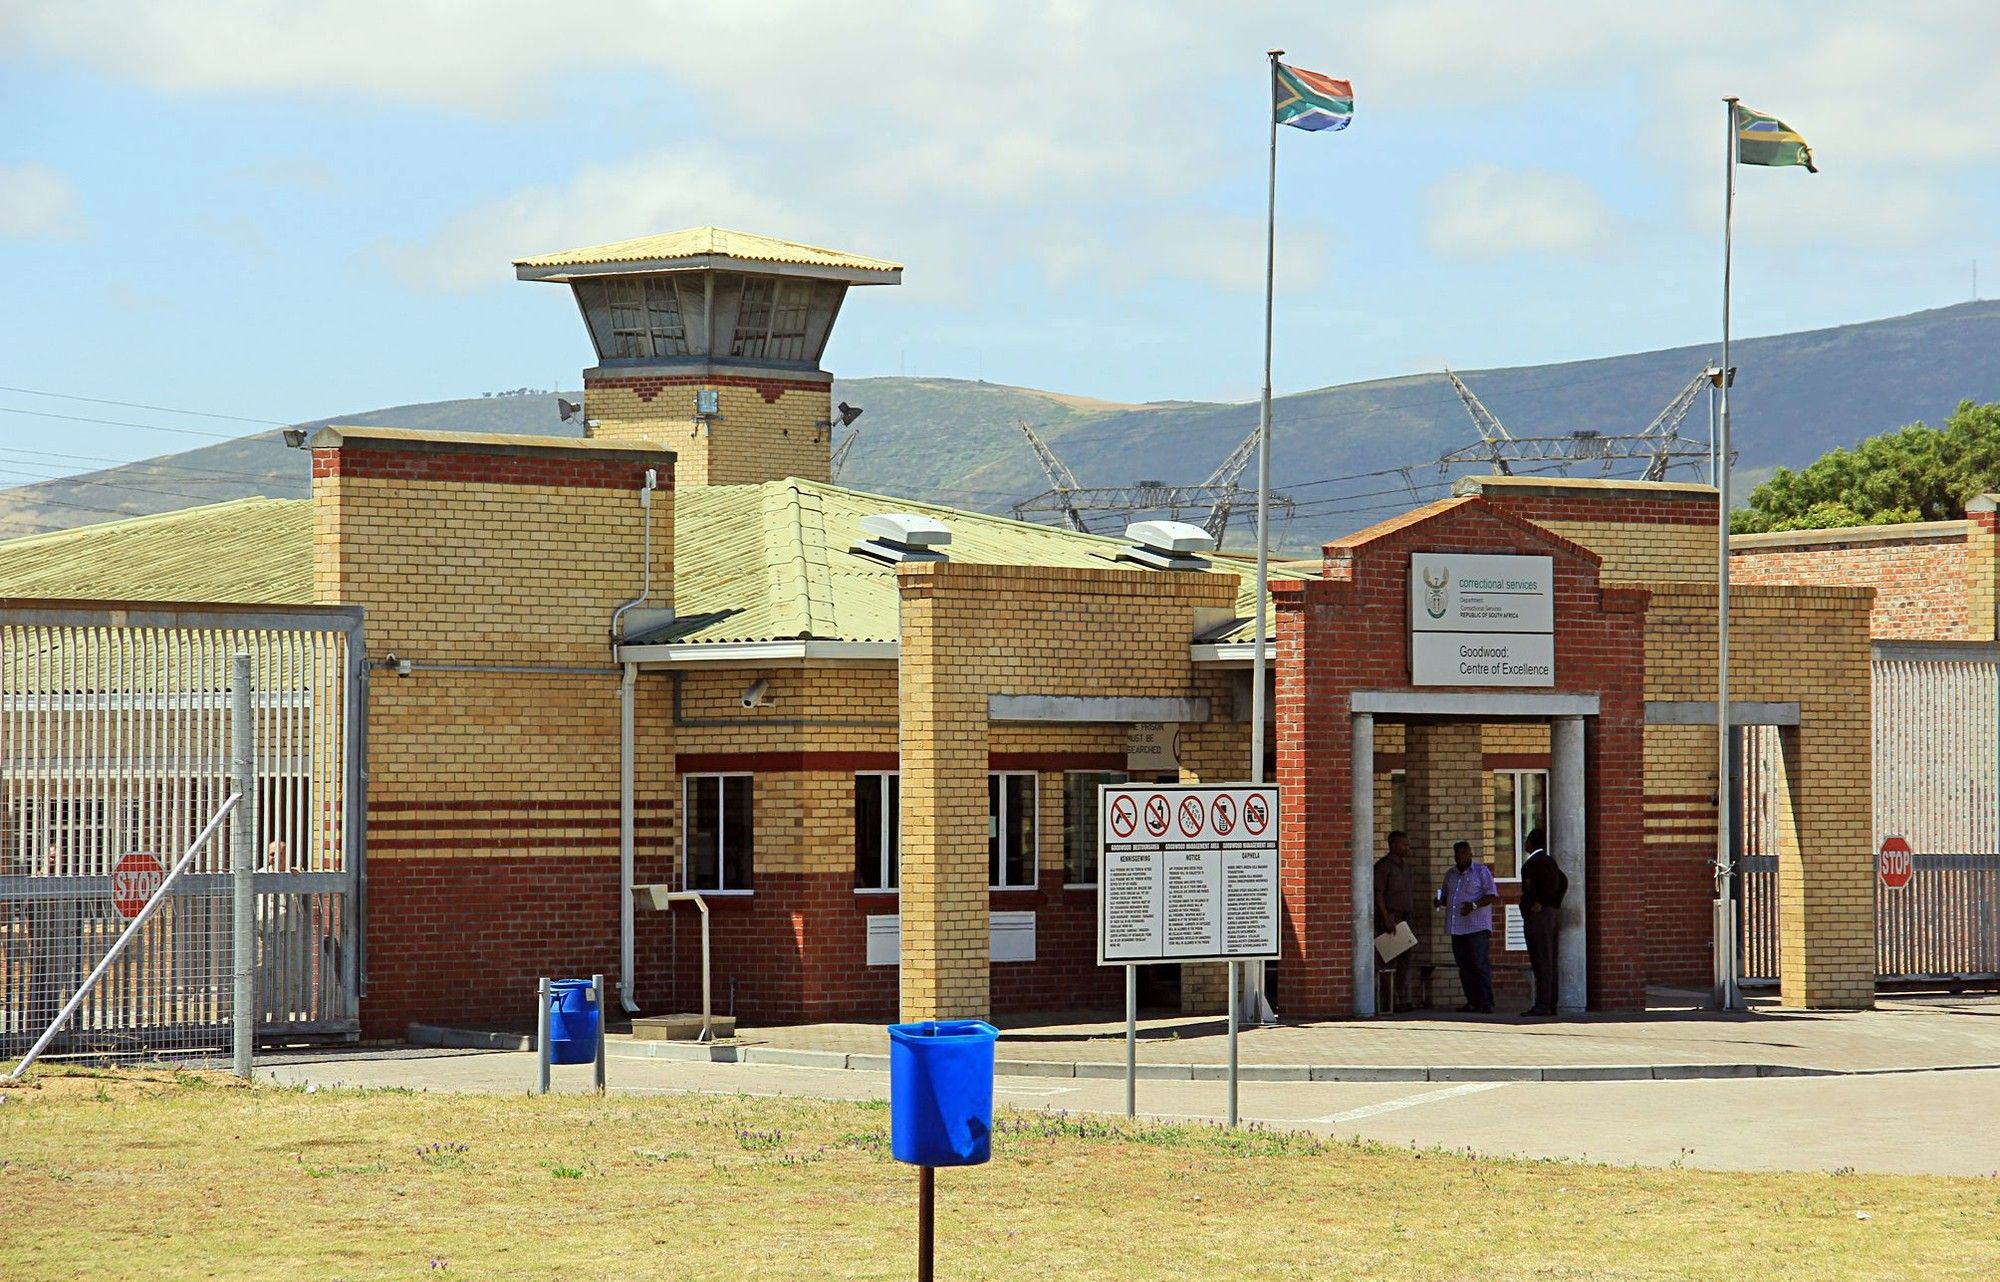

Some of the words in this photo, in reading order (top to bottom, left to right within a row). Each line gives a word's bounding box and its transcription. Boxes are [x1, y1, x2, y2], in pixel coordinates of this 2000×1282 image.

[1459, 578, 1504, 590] correctional
[1506, 581, 1538, 590] services
[1459, 645, 1509, 658] Goodwood:
[1459, 662, 1489, 675] Centre
[1491, 662, 1500, 675] of
[1502, 662, 1549, 675] Excellence
[1146, 734, 1154, 743] BE
[1127, 745, 1161, 754] SEARCHED
[1882, 850, 1910, 875] STOP
[116, 871, 161, 900] STOP
